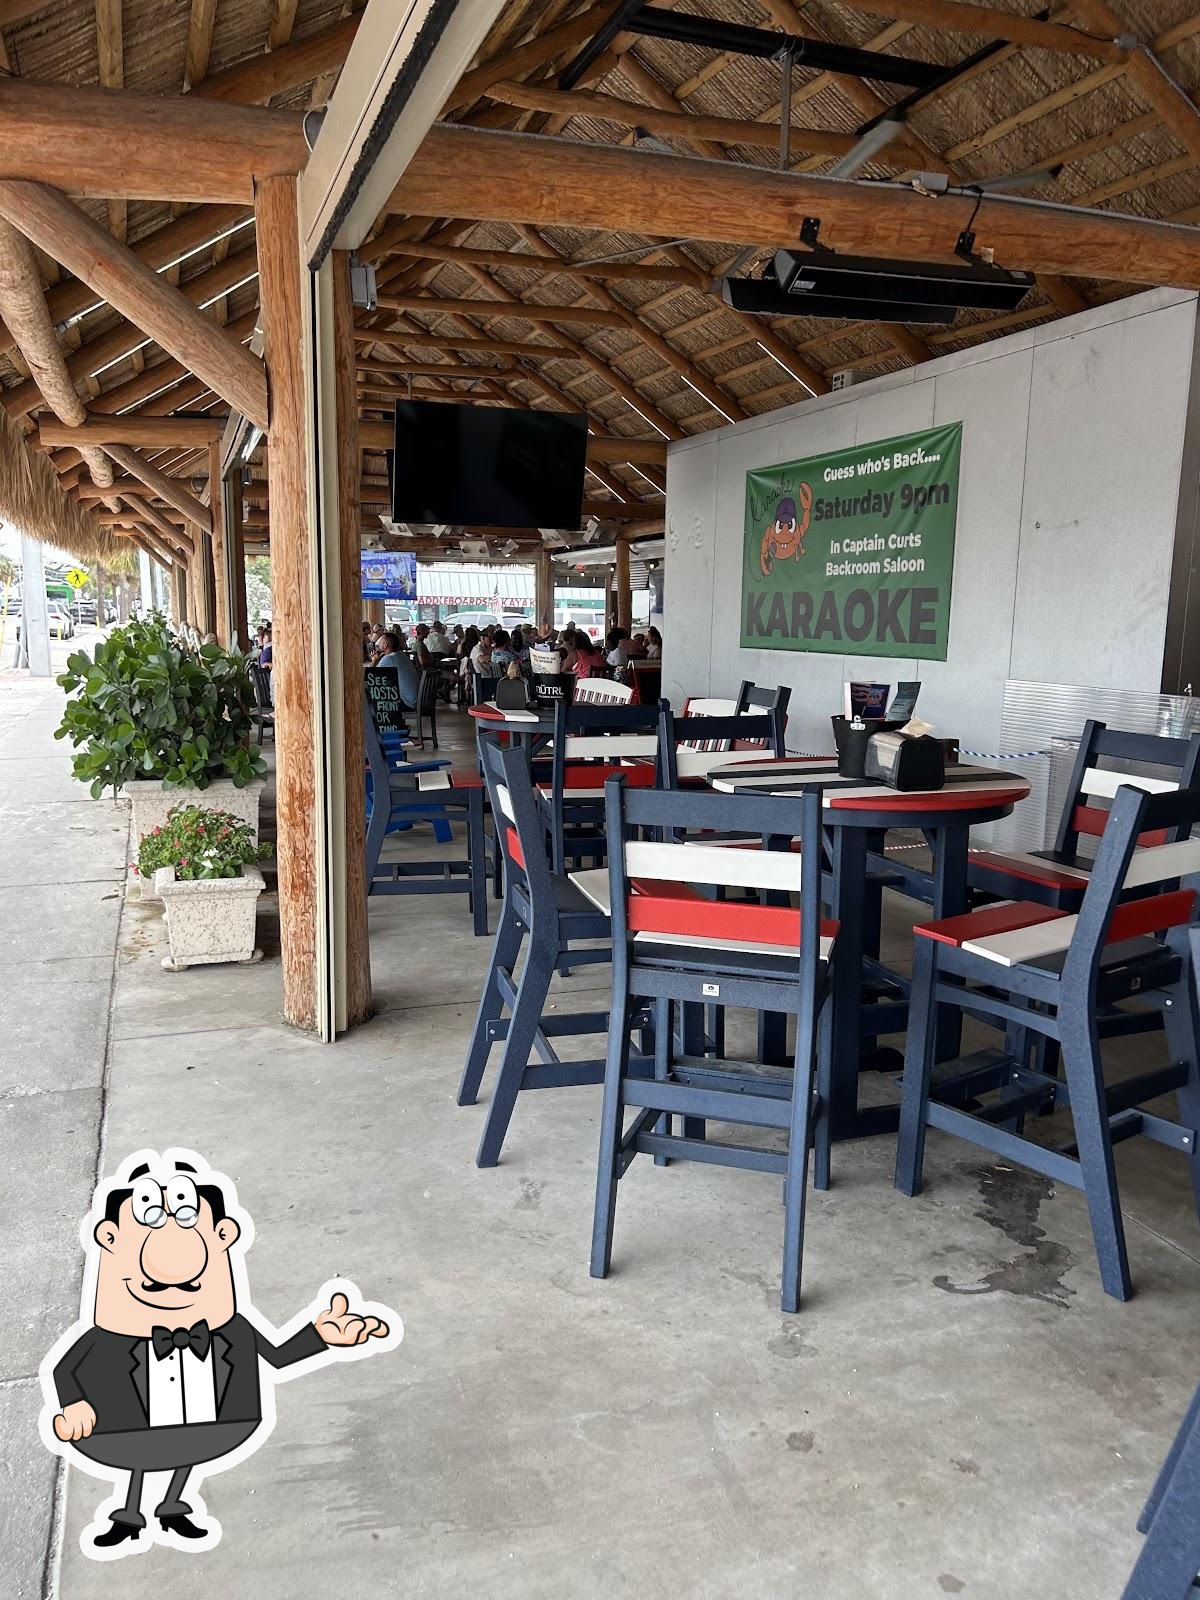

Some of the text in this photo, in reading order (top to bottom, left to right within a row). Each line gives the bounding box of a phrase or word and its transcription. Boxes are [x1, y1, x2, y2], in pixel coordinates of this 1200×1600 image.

[823, 465, 855, 481] Guess
[857, 455, 890, 476] who's
[814, 482, 950, 522] Saturday 9pm
[830, 531, 921, 556] In Captain Curts
[825, 556, 925, 576] Backroom Saloon
[413, 596, 488, 606] ADDLEBOARDS
[746, 587, 939, 645] KARAOKE
